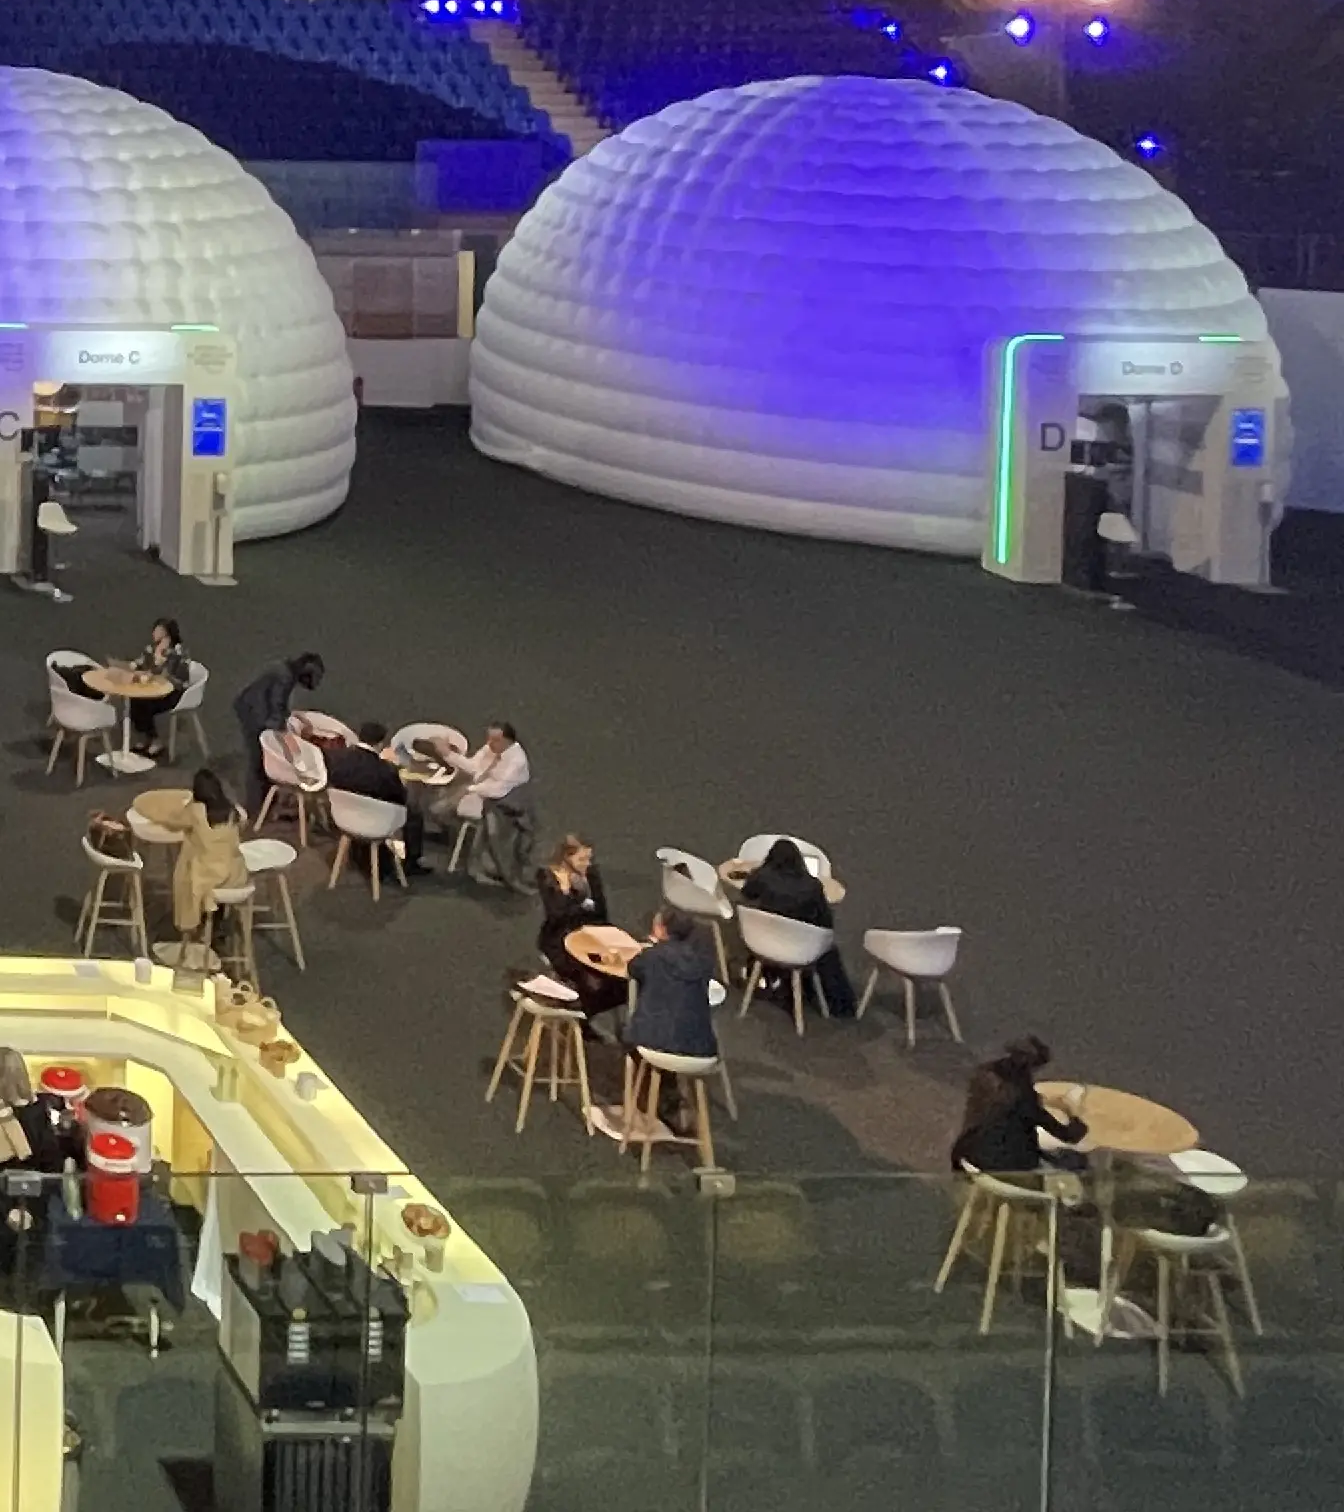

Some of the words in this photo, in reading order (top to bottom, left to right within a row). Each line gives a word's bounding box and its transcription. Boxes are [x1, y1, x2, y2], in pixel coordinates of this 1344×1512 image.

[78, 350, 124, 364] Dome
[128, 350, 140, 364] C
[1040, 422, 1065, 451] D
